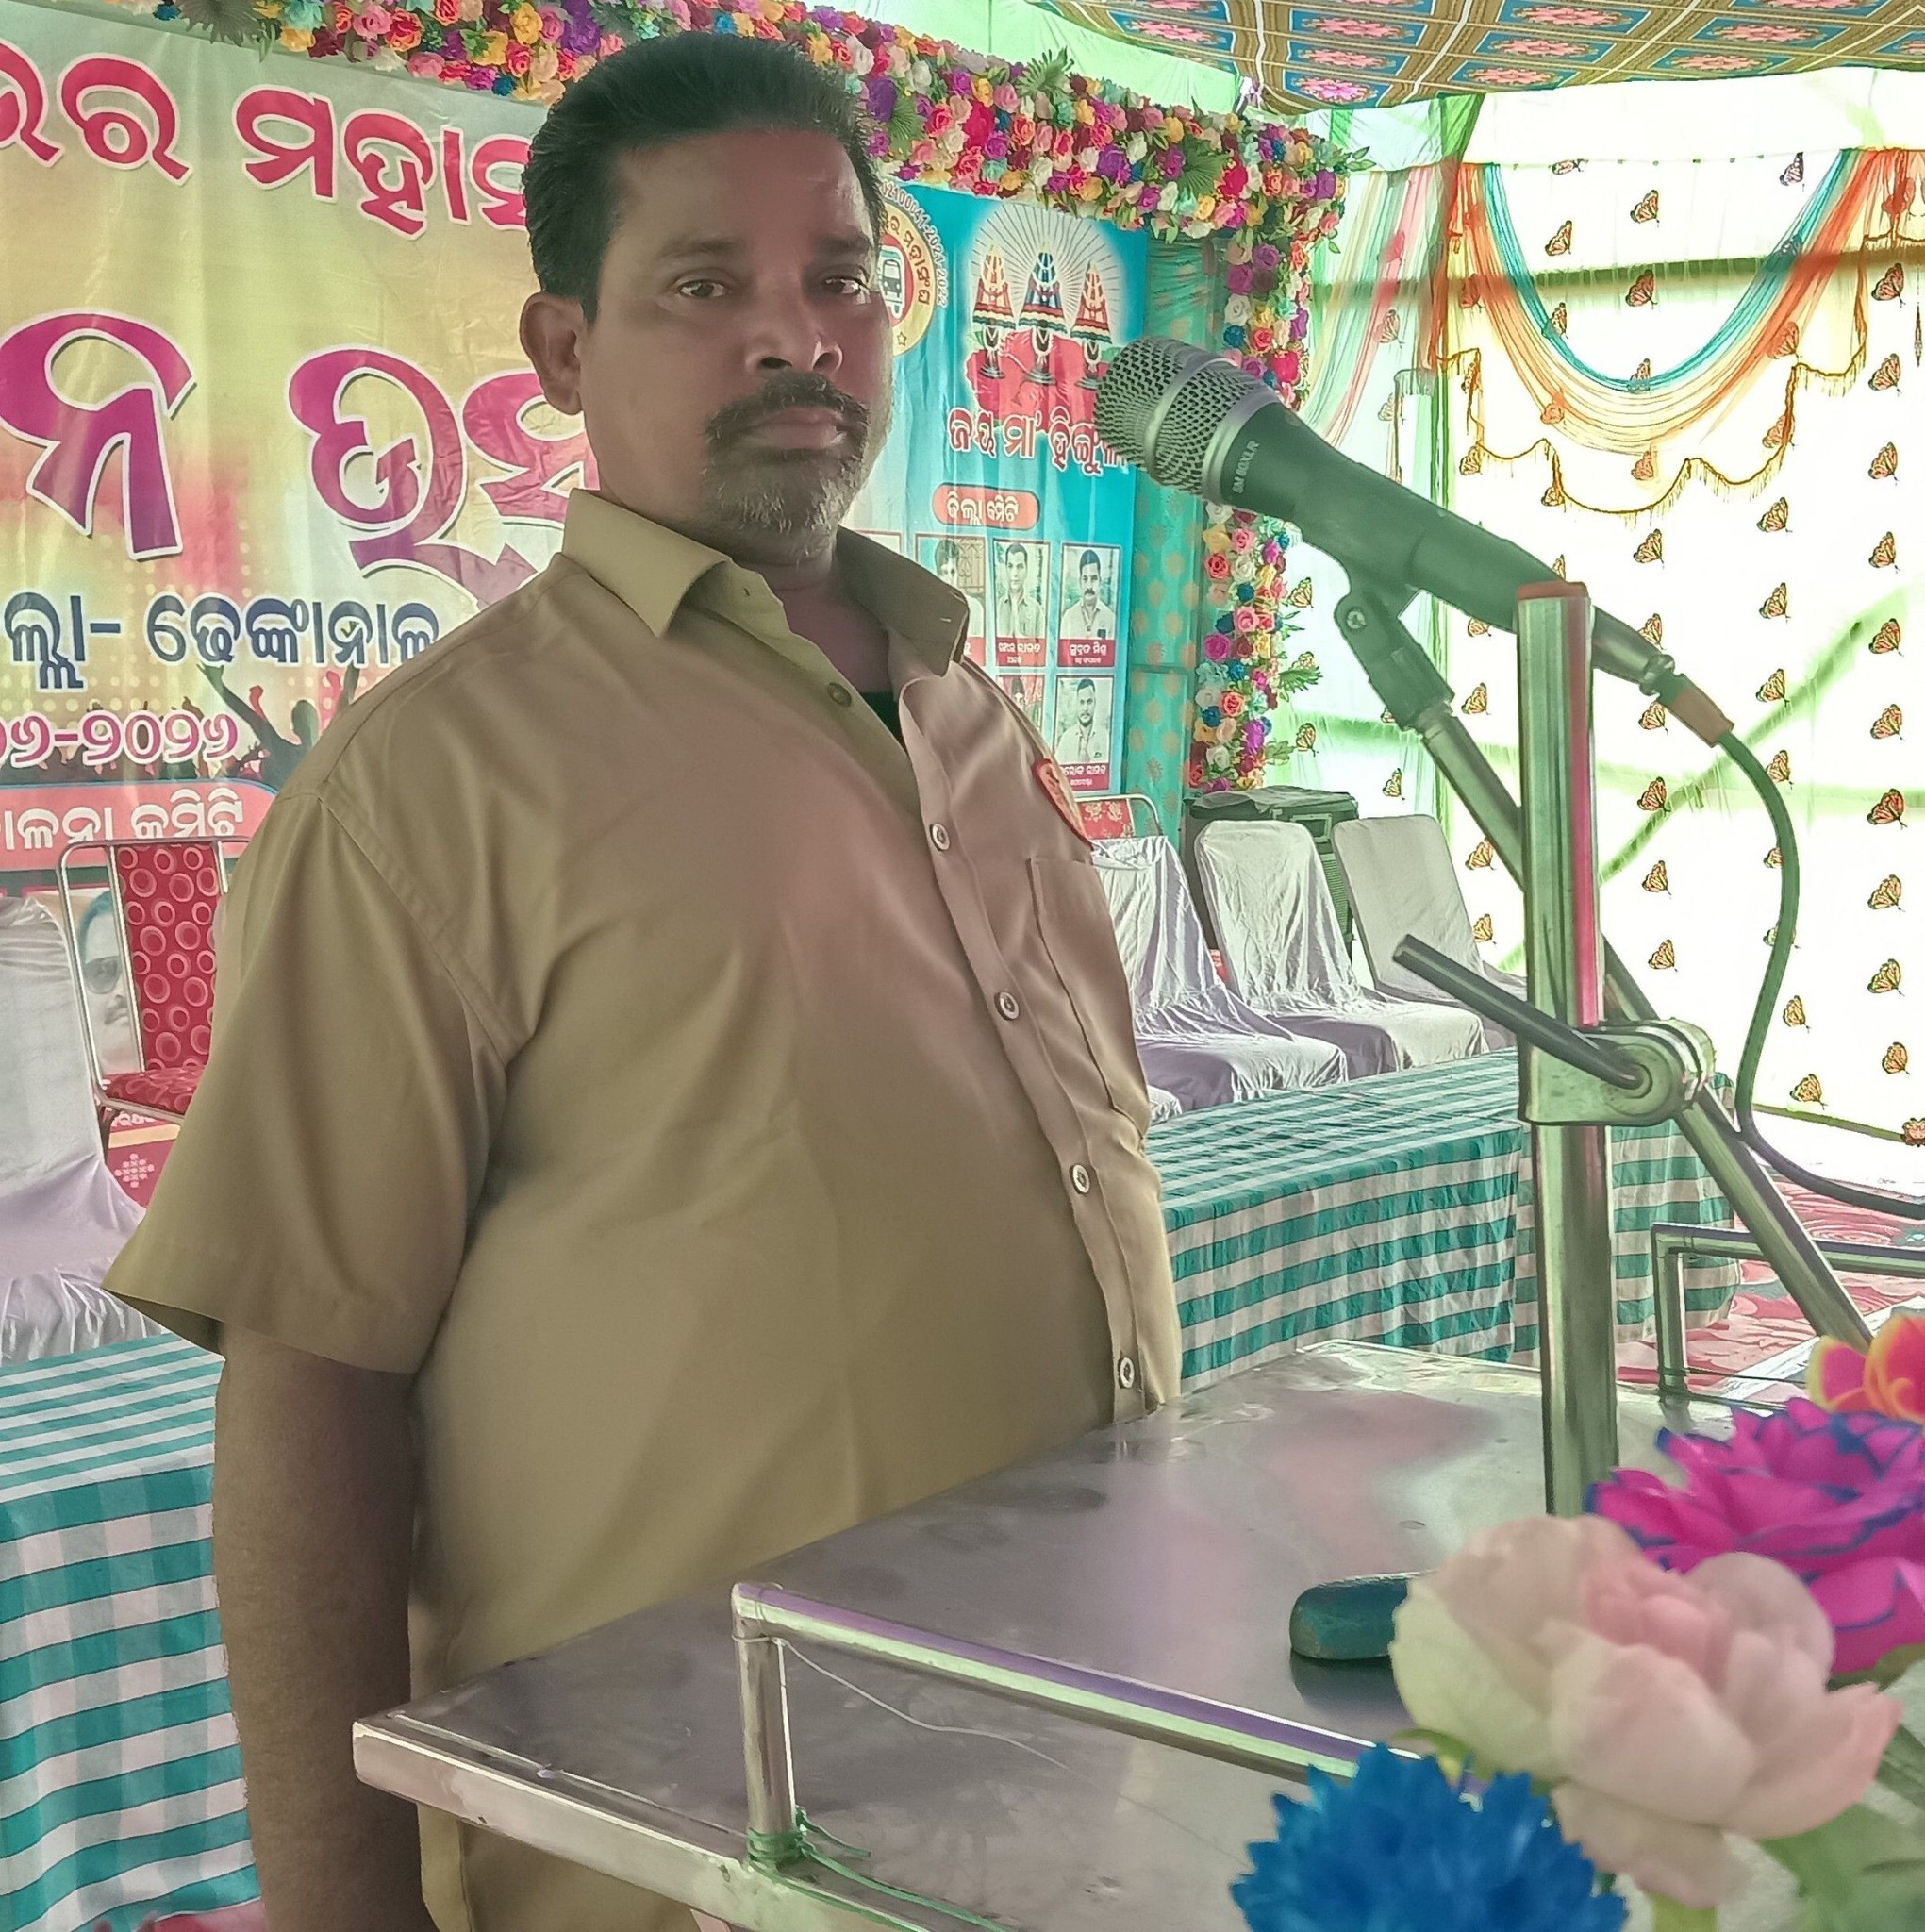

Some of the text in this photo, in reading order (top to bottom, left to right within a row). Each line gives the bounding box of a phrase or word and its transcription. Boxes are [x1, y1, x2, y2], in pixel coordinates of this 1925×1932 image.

[234, 87, 530, 238] ମହାସ
[948, 407, 997, 459] ଜୟ
[0, 712, 239, 765] ୬-୨୦୨୬
